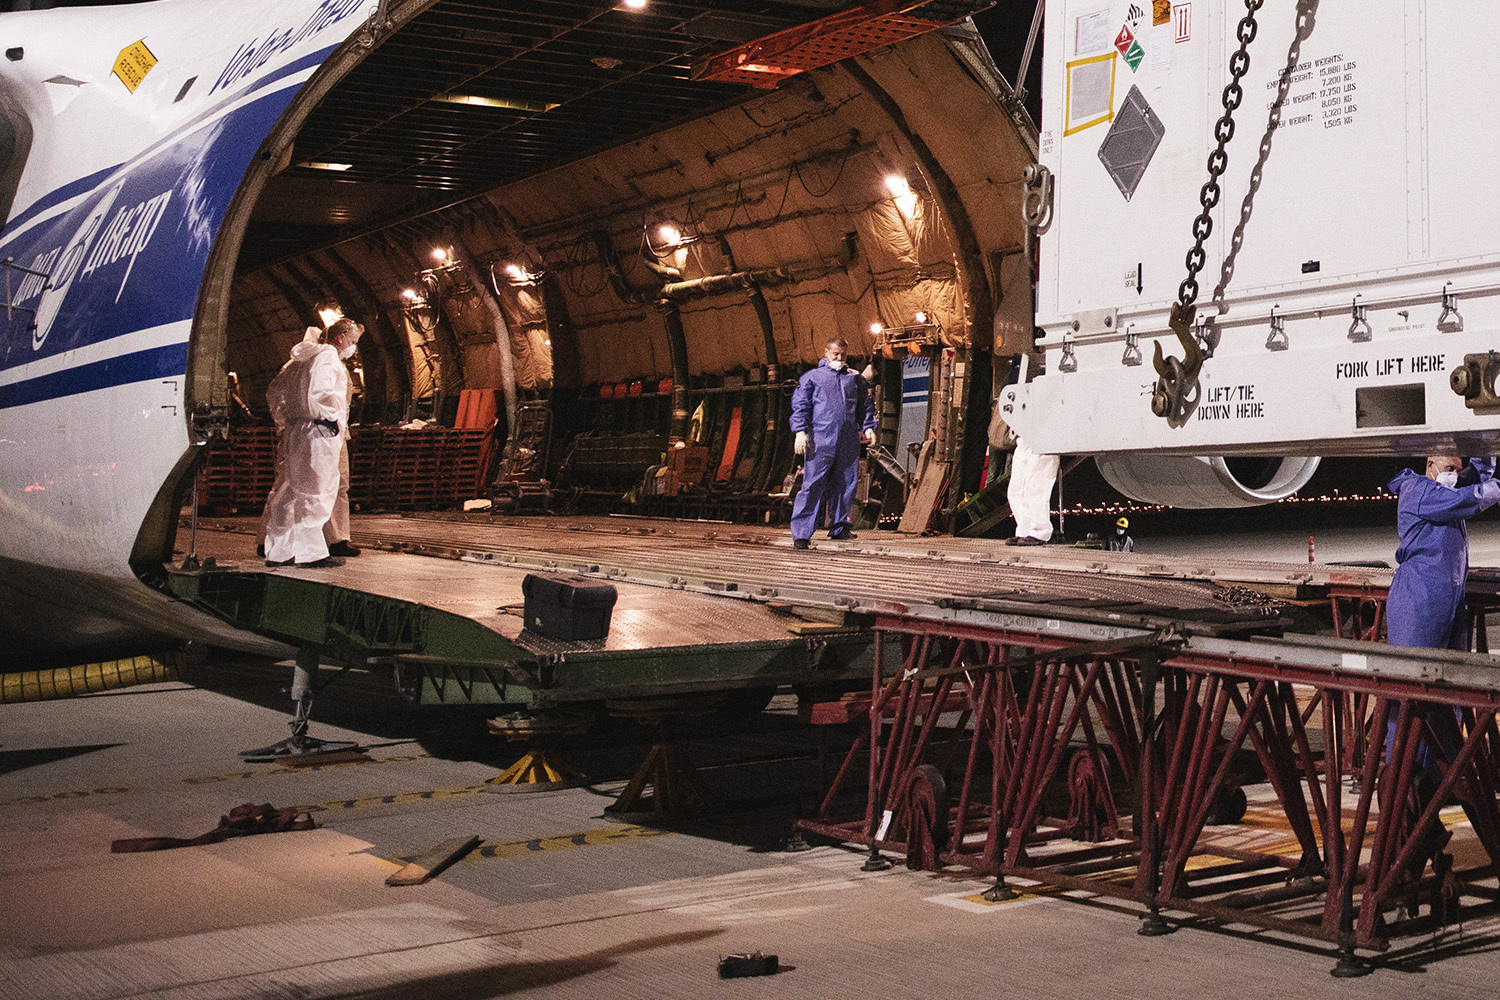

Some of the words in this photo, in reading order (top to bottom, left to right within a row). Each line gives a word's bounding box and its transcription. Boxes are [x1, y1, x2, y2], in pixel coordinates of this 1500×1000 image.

[119, 59, 141, 86] RESCUE
[1278, 61, 1312, 77] CONTAINER
[1315, 54, 1344, 68] WEIGHTS:
[1289, 71, 1314, 84] WEIGHT:
[1343, 61, 1357, 71] LBS
[1343, 73, 1353, 82] KG
[1293, 92, 1317, 104] WEIGHT:
[1343, 82, 1357, 93] LBS
[1343, 94, 1353, 104] KG
[1289, 113, 1313, 126] WEIGHT:
[1344, 104, 1358, 113] LBS
[1344, 115, 1353, 125] KG
[1336, 360, 1369, 379] FORK
[1376, 357, 1404, 376] LIFT
[1411, 354, 1446, 373] HERE
[1207, 385, 1255, 403] LIFT/TIE
[1198, 403, 1231, 421] DOWN
[1236, 402, 1265, 420] HERE
